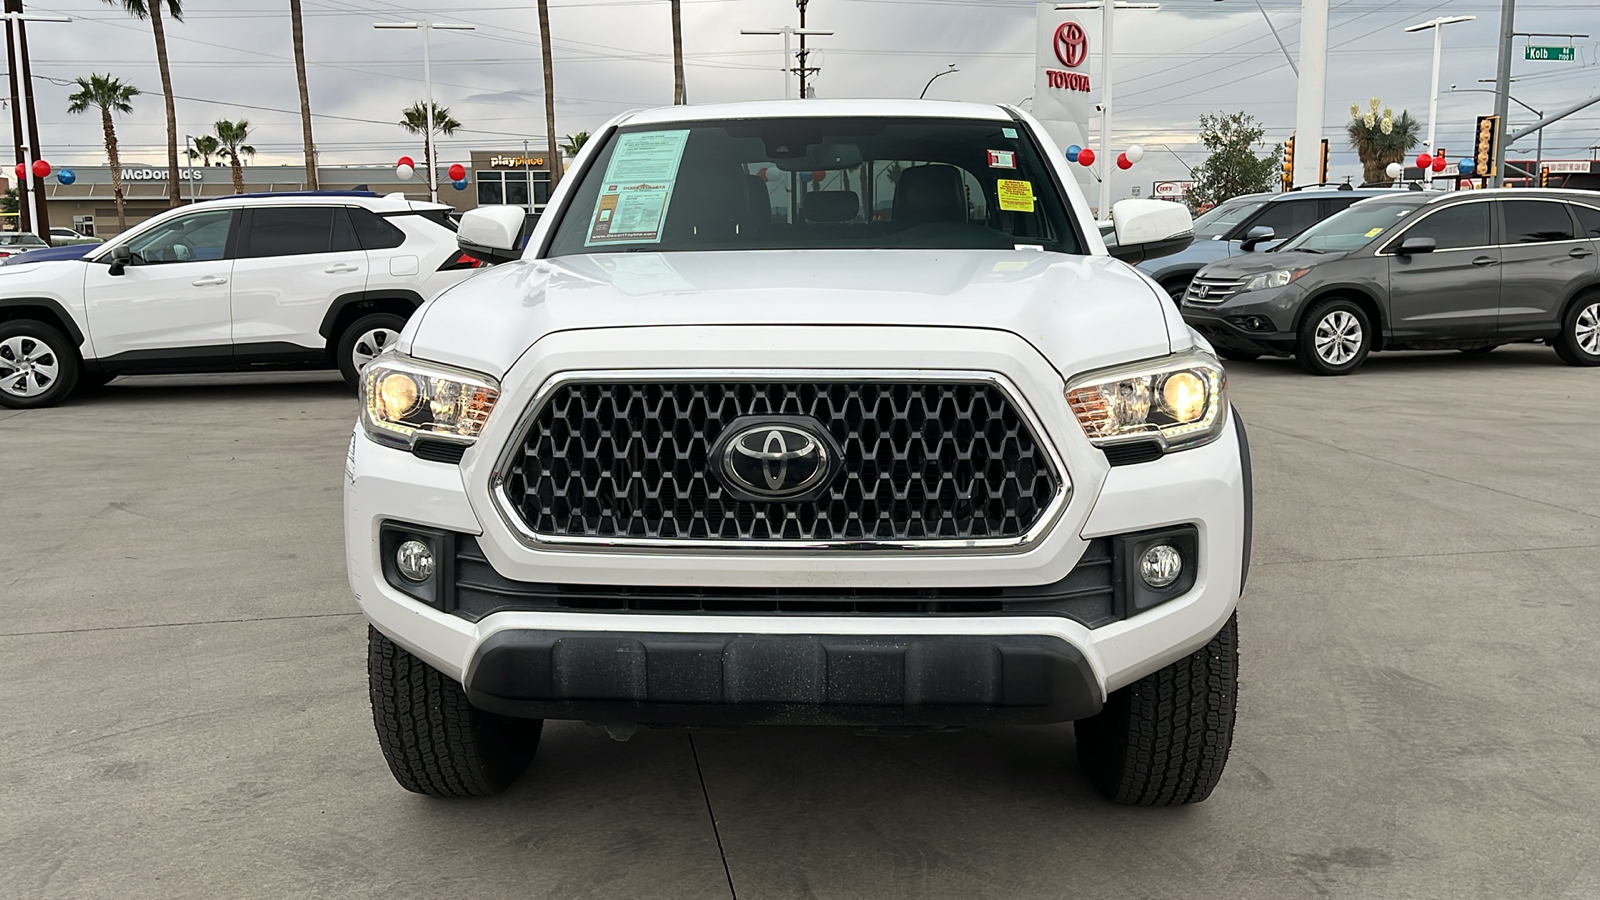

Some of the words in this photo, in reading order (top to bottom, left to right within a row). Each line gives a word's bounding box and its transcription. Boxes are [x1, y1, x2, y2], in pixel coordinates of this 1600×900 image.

[1530, 47, 1548, 59] Kolb
[1046, 70, 1091, 92] TOYOTA
[121, 169, 203, 180] McDonld's
